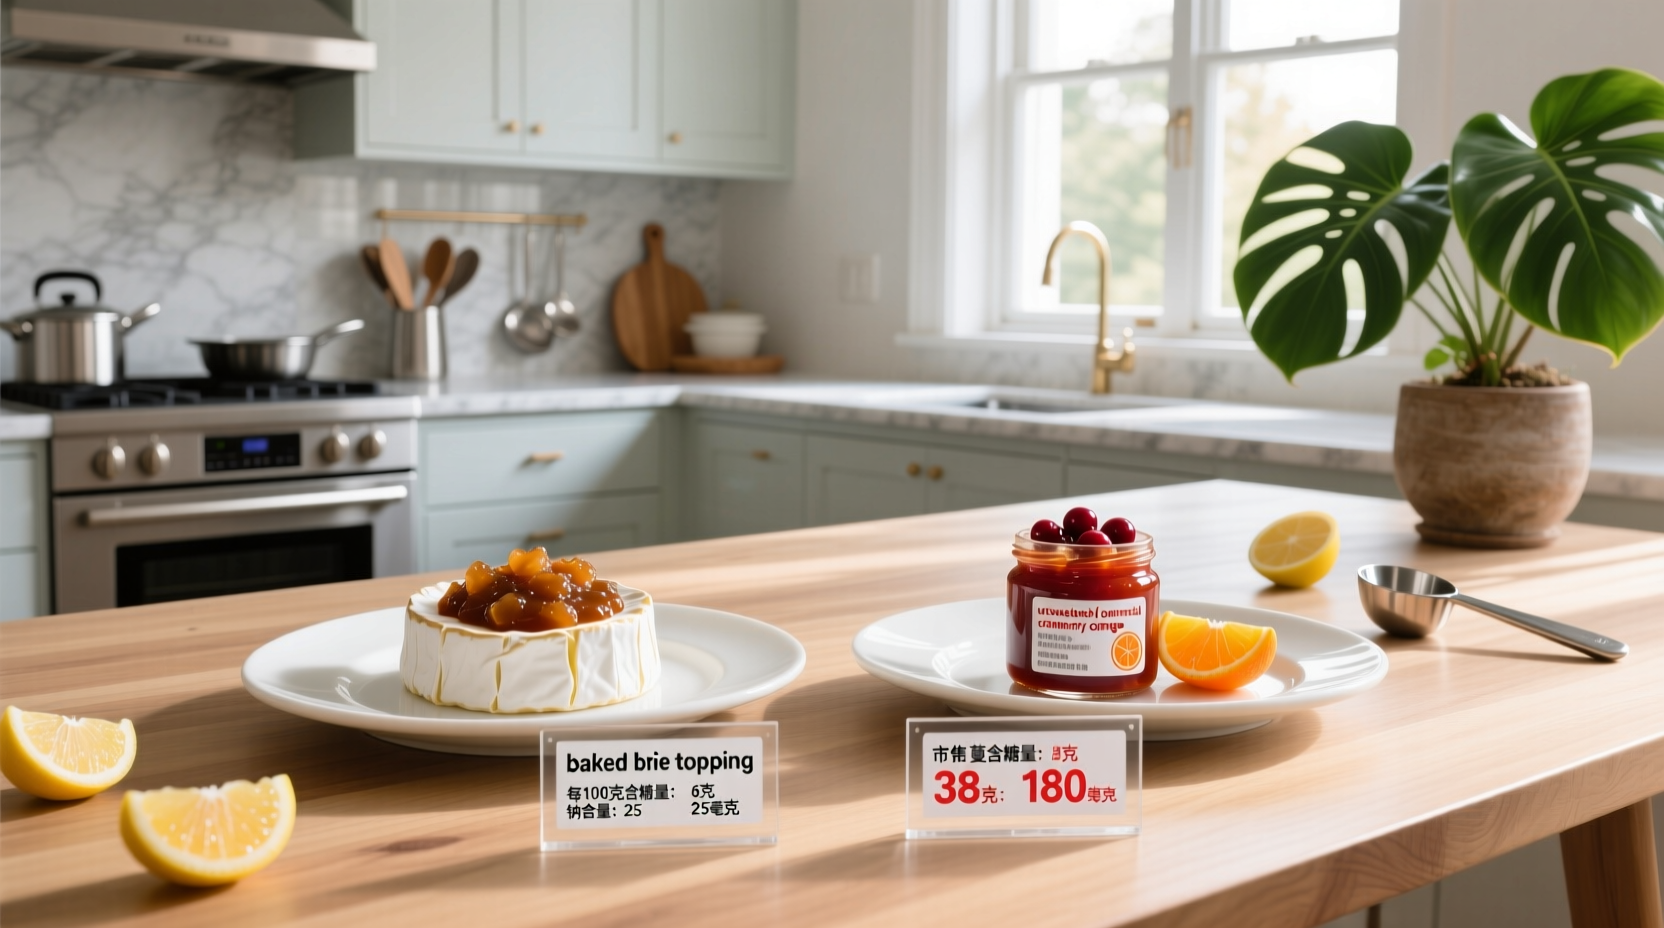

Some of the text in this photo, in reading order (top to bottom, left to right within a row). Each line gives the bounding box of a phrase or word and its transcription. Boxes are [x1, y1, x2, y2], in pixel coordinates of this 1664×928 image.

[566, 750, 754, 775] baked brie topping
[691, 783, 715, 799] 6克
